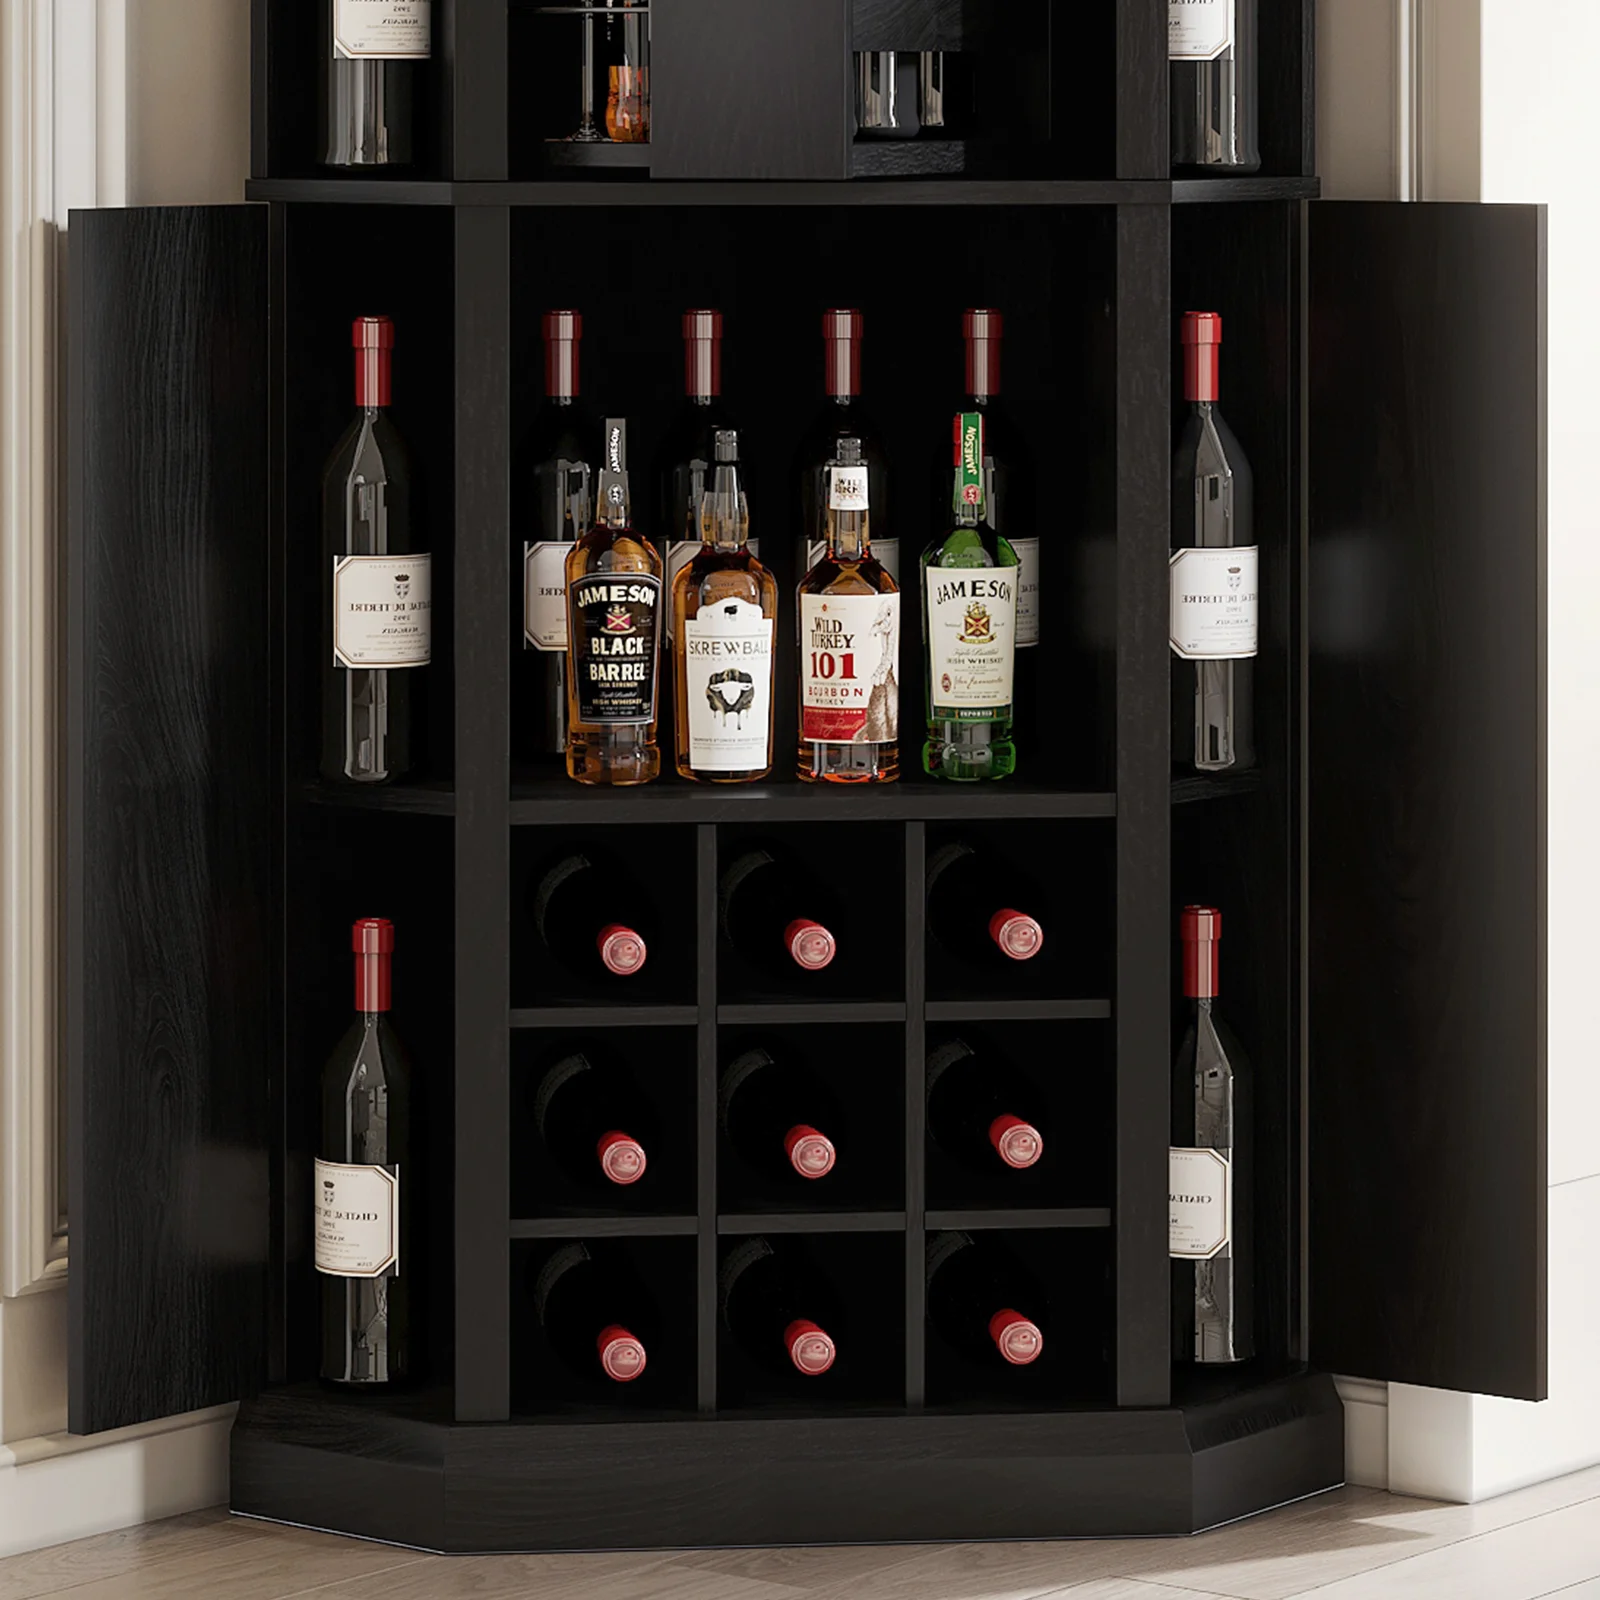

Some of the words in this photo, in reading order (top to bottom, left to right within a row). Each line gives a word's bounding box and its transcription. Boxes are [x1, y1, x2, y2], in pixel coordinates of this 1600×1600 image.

[610, 427, 620, 473] JAMESON
[965, 426, 977, 475] JAMESON
[578, 585, 655, 607] JAMESON
[937, 580, 1012, 604] JAMESON
[815, 616, 843, 634] WILD
[591, 637, 644, 655] BLACK
[689, 641, 768, 655] SKREWBALL
[811, 629, 855, 650] TURKEY
[590, 662, 645, 681] BARREL
[810, 651, 858, 679] 101
[808, 686, 863, 697] BOURBON
